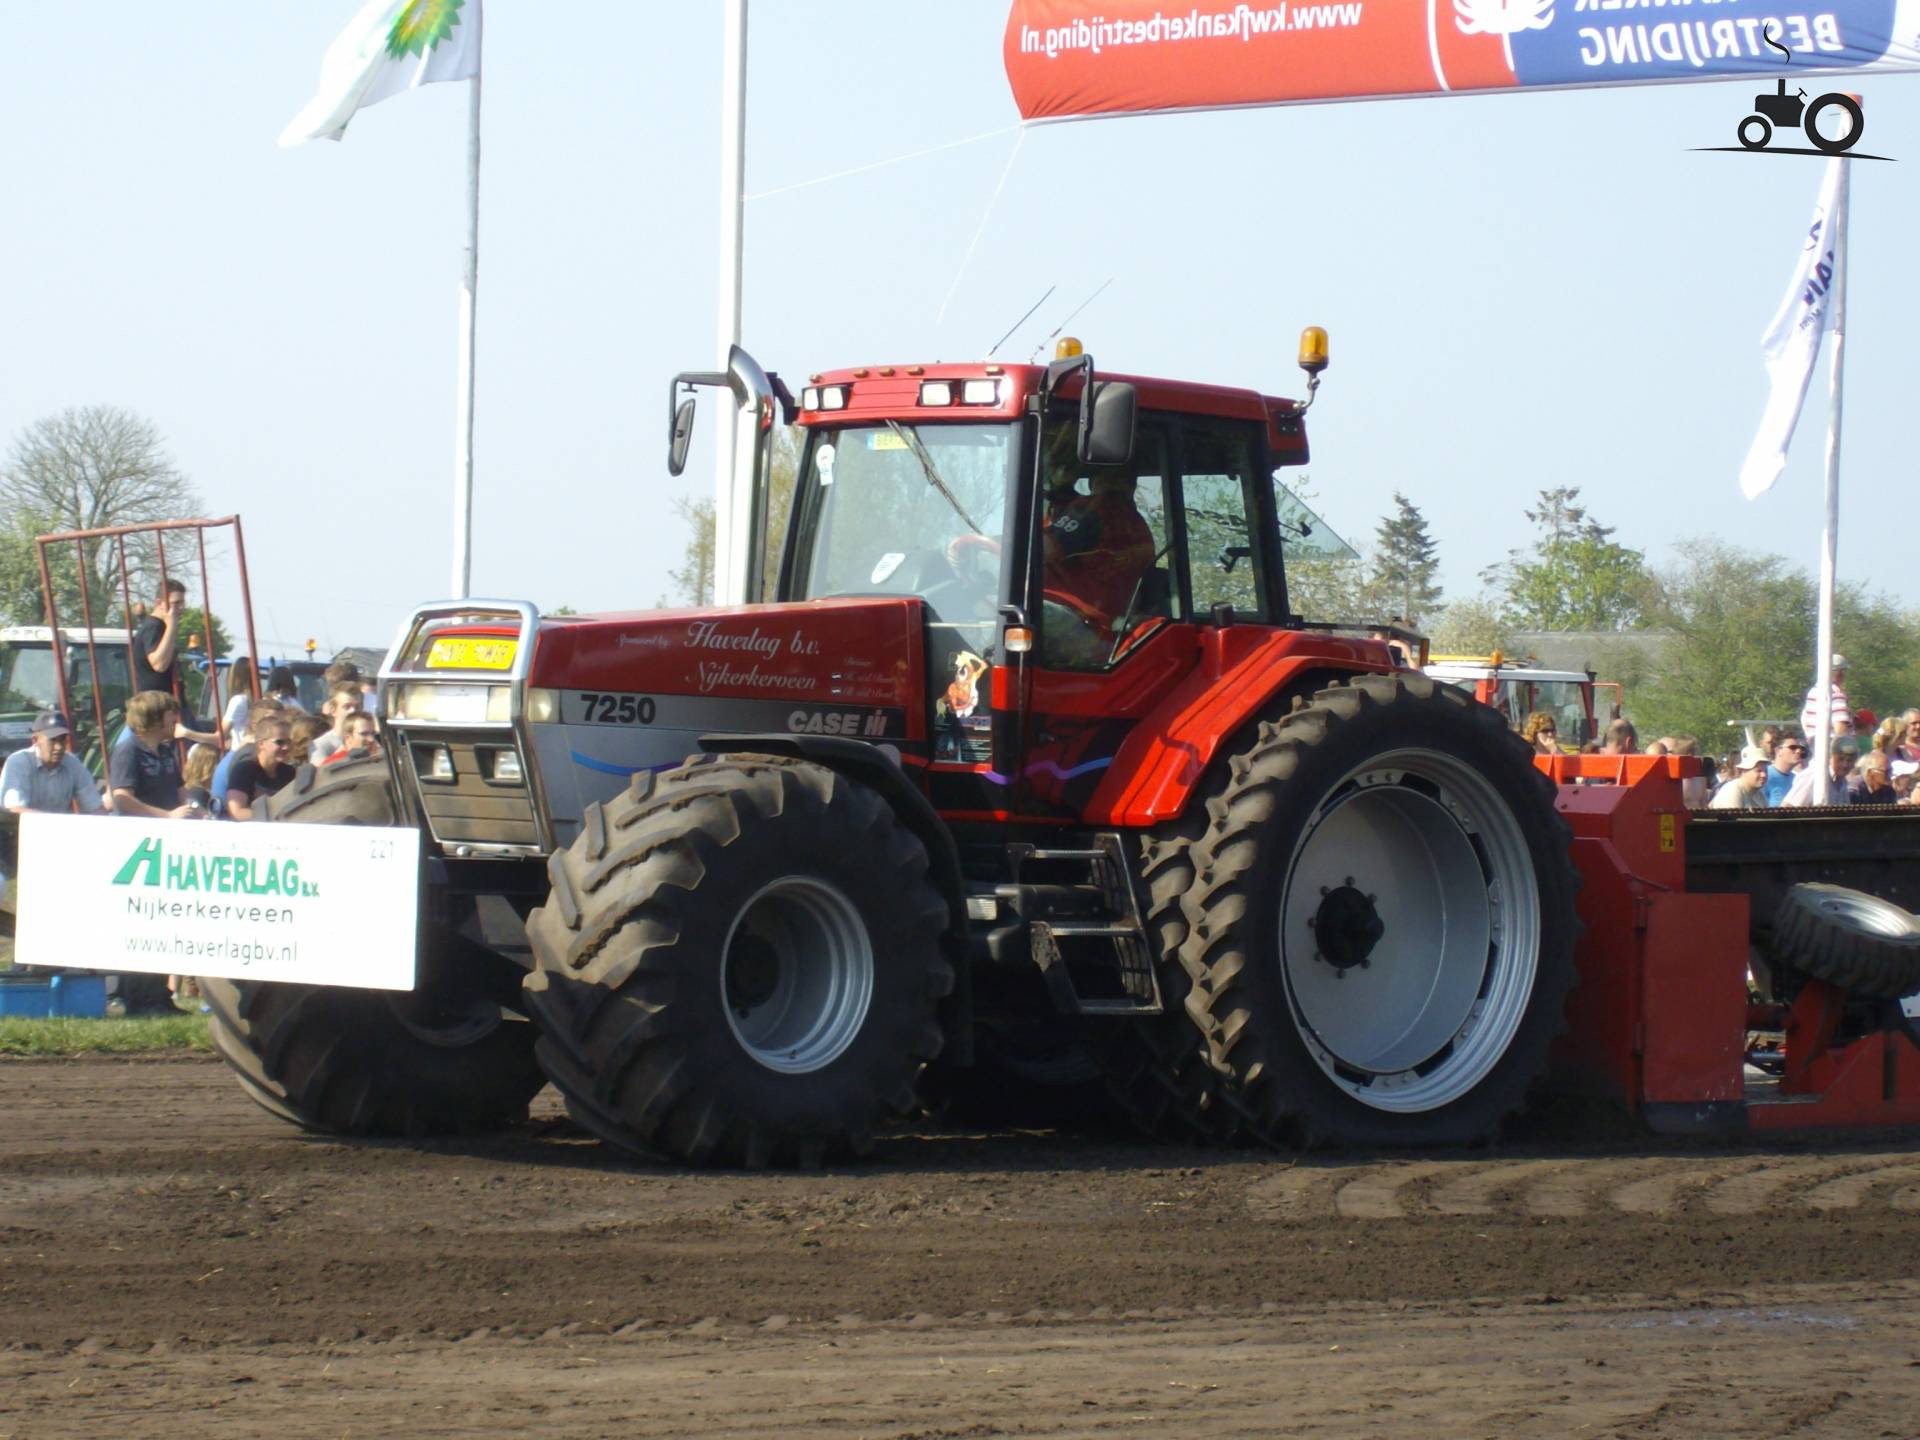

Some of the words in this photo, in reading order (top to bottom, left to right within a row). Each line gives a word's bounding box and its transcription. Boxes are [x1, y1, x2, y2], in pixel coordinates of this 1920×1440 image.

[684, 621, 781, 660] Haverlag
[790, 629, 820, 655] b.v.
[581, 694, 656, 725] 7250
[788, 710, 860, 734] CASE
[166, 853, 299, 897] HAVERLAG
[128, 896, 293, 923] Nijkerkerveen
[125, 934, 298, 965] www.haverlagbv.nl
